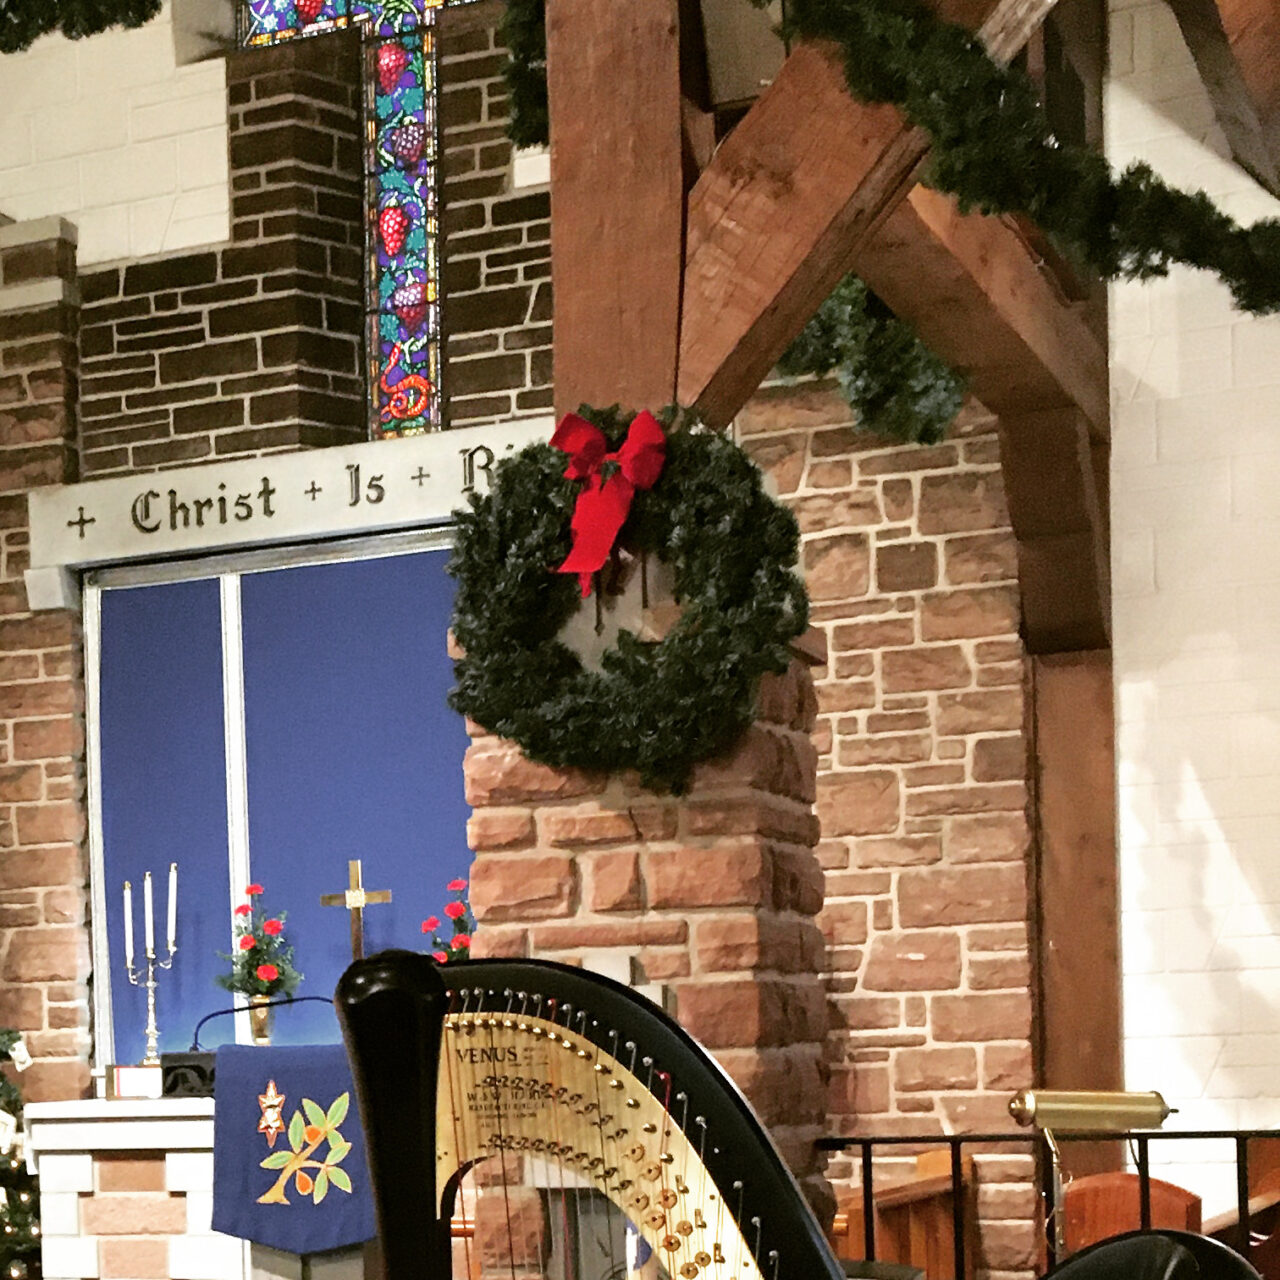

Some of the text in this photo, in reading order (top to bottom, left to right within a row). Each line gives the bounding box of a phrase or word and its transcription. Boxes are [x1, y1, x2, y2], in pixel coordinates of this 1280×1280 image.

[131, 463, 385, 534] Christ Is
[455, 1046, 518, 1064] VENUS
